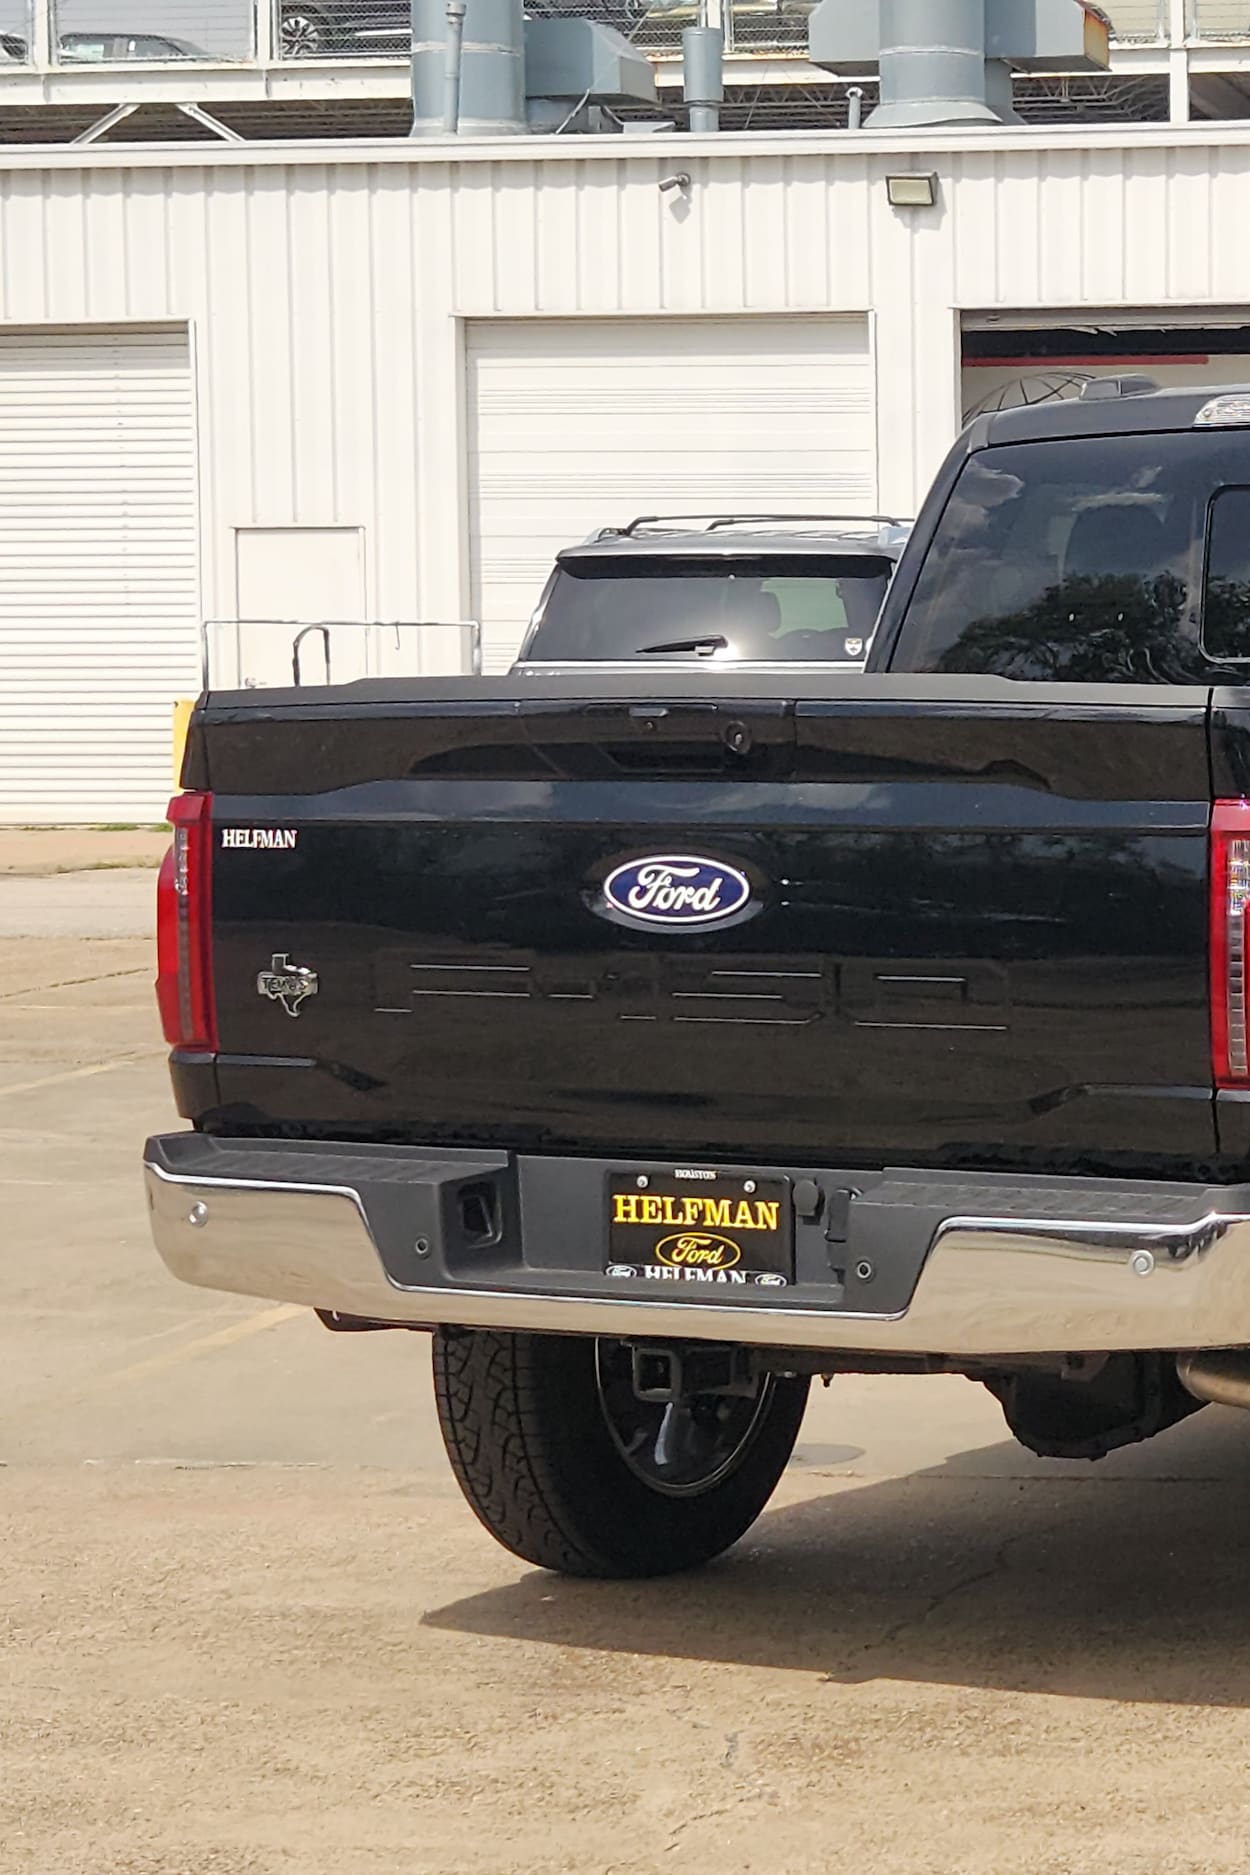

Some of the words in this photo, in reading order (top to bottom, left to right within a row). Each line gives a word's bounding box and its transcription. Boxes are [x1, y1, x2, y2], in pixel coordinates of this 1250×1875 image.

[221, 828, 298, 849] HELFMAN
[627, 864, 724, 911] Ford
[612, 1194, 780, 1231] HELFMAN
[671, 1236, 725, 1265] Ford
